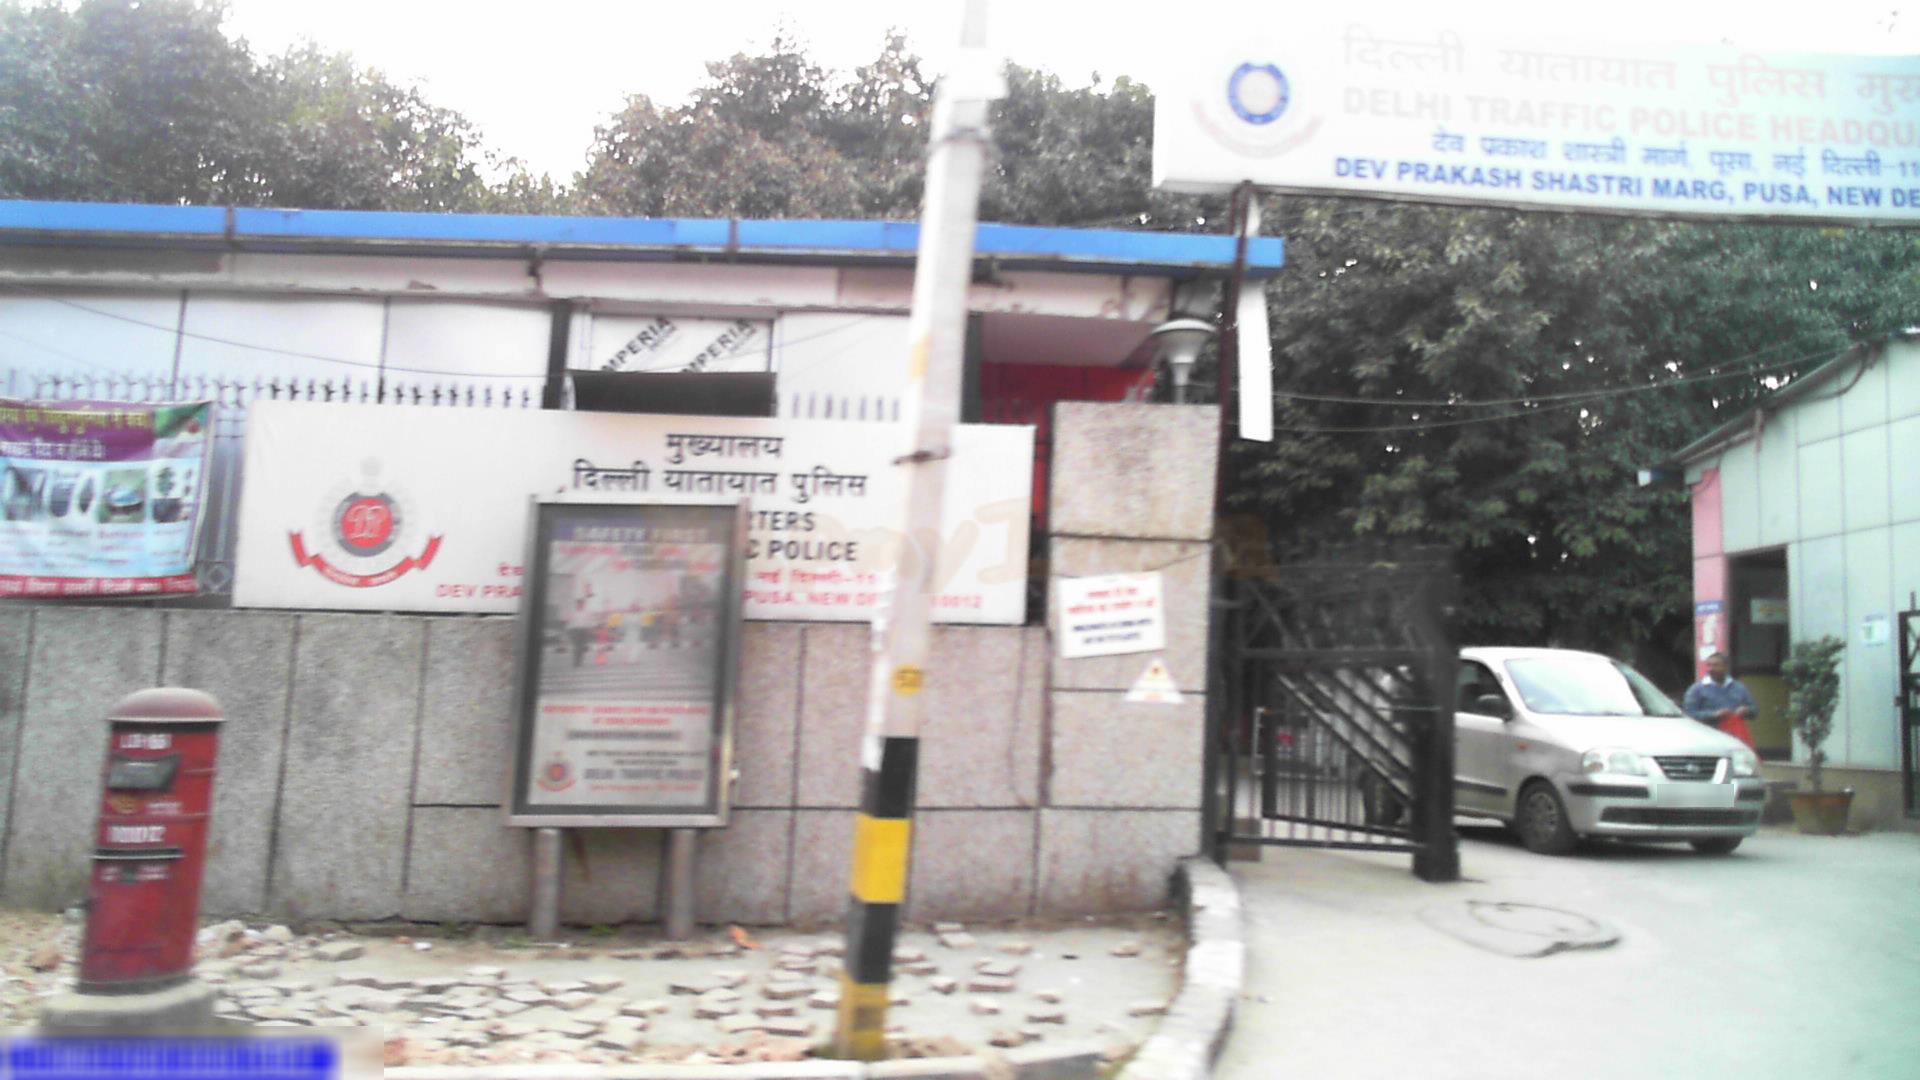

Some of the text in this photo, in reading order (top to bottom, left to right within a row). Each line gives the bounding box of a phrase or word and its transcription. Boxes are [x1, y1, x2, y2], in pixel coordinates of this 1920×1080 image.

[1341, 23, 1465, 74] दिल्ली
[1498, 49, 1677, 91] यातायात
[1706, 53, 1826, 108] पुलिस
[1343, 86, 1920, 147] DELHI TRAFFIC POLICE HEADQU
[1334, 156, 1389, 181] DEV
[1396, 161, 1522, 190] PRAKASH
[1531, 170, 1643, 197] SHASTRI
[1652, 177, 1735, 206] MARG,
[1743, 182, 1818, 208] PUSA,
[1827, 186, 1882, 208] NEW
[665, 433, 784, 464] मुख्यालय
[573, 458, 868, 504] दिल्ली यातायात पुलिस
[767, 540, 859, 562] POLICE
[436, 584, 477, 598] DEV
